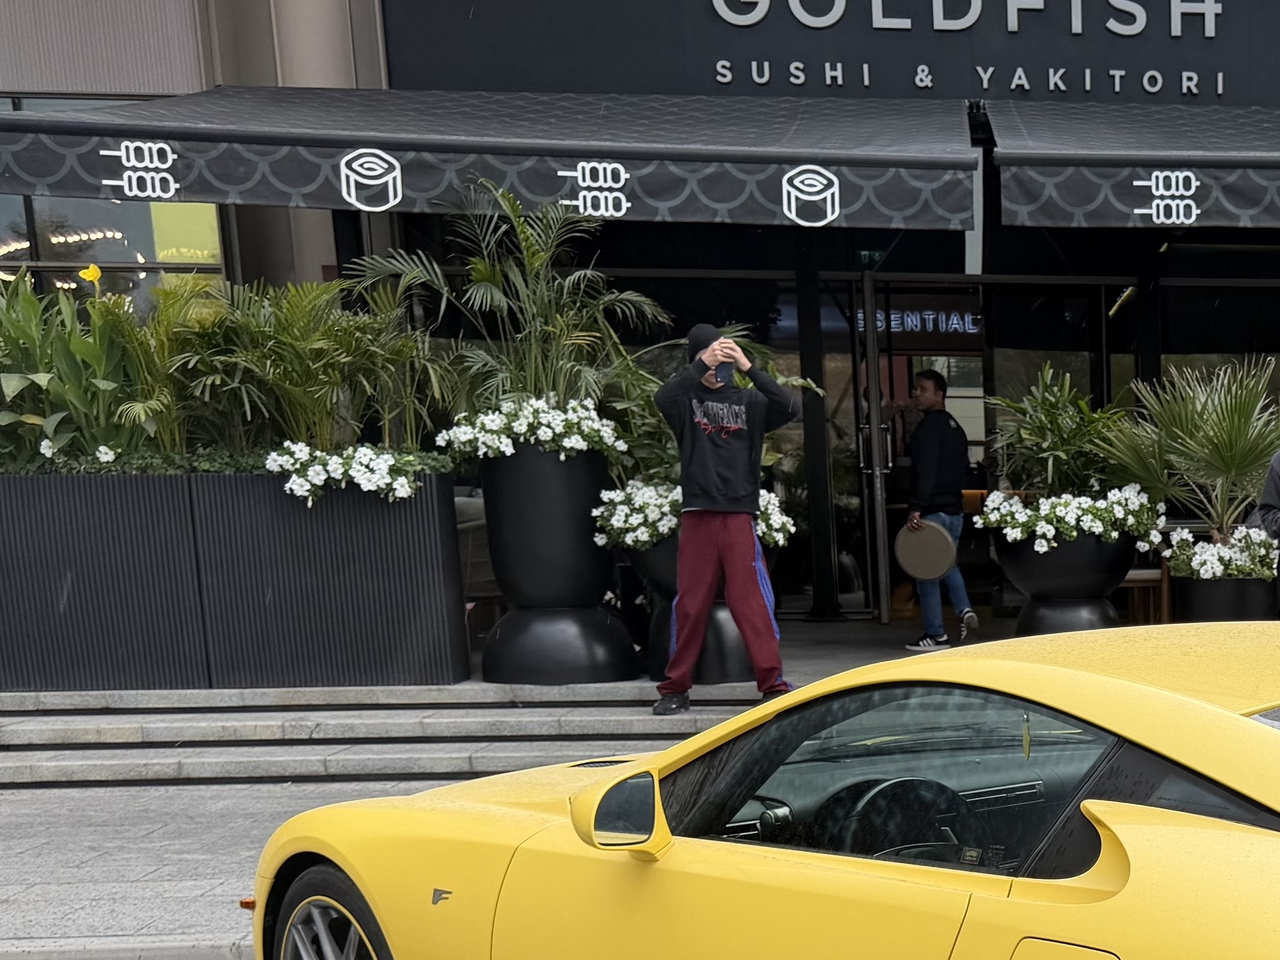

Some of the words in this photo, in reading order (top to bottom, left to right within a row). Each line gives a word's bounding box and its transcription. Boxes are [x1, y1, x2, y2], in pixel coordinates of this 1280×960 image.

[715, 59, 870, 87] SUSHI
[914, 64, 934, 89] &
[976, 66, 1224, 95] YAKITORI
